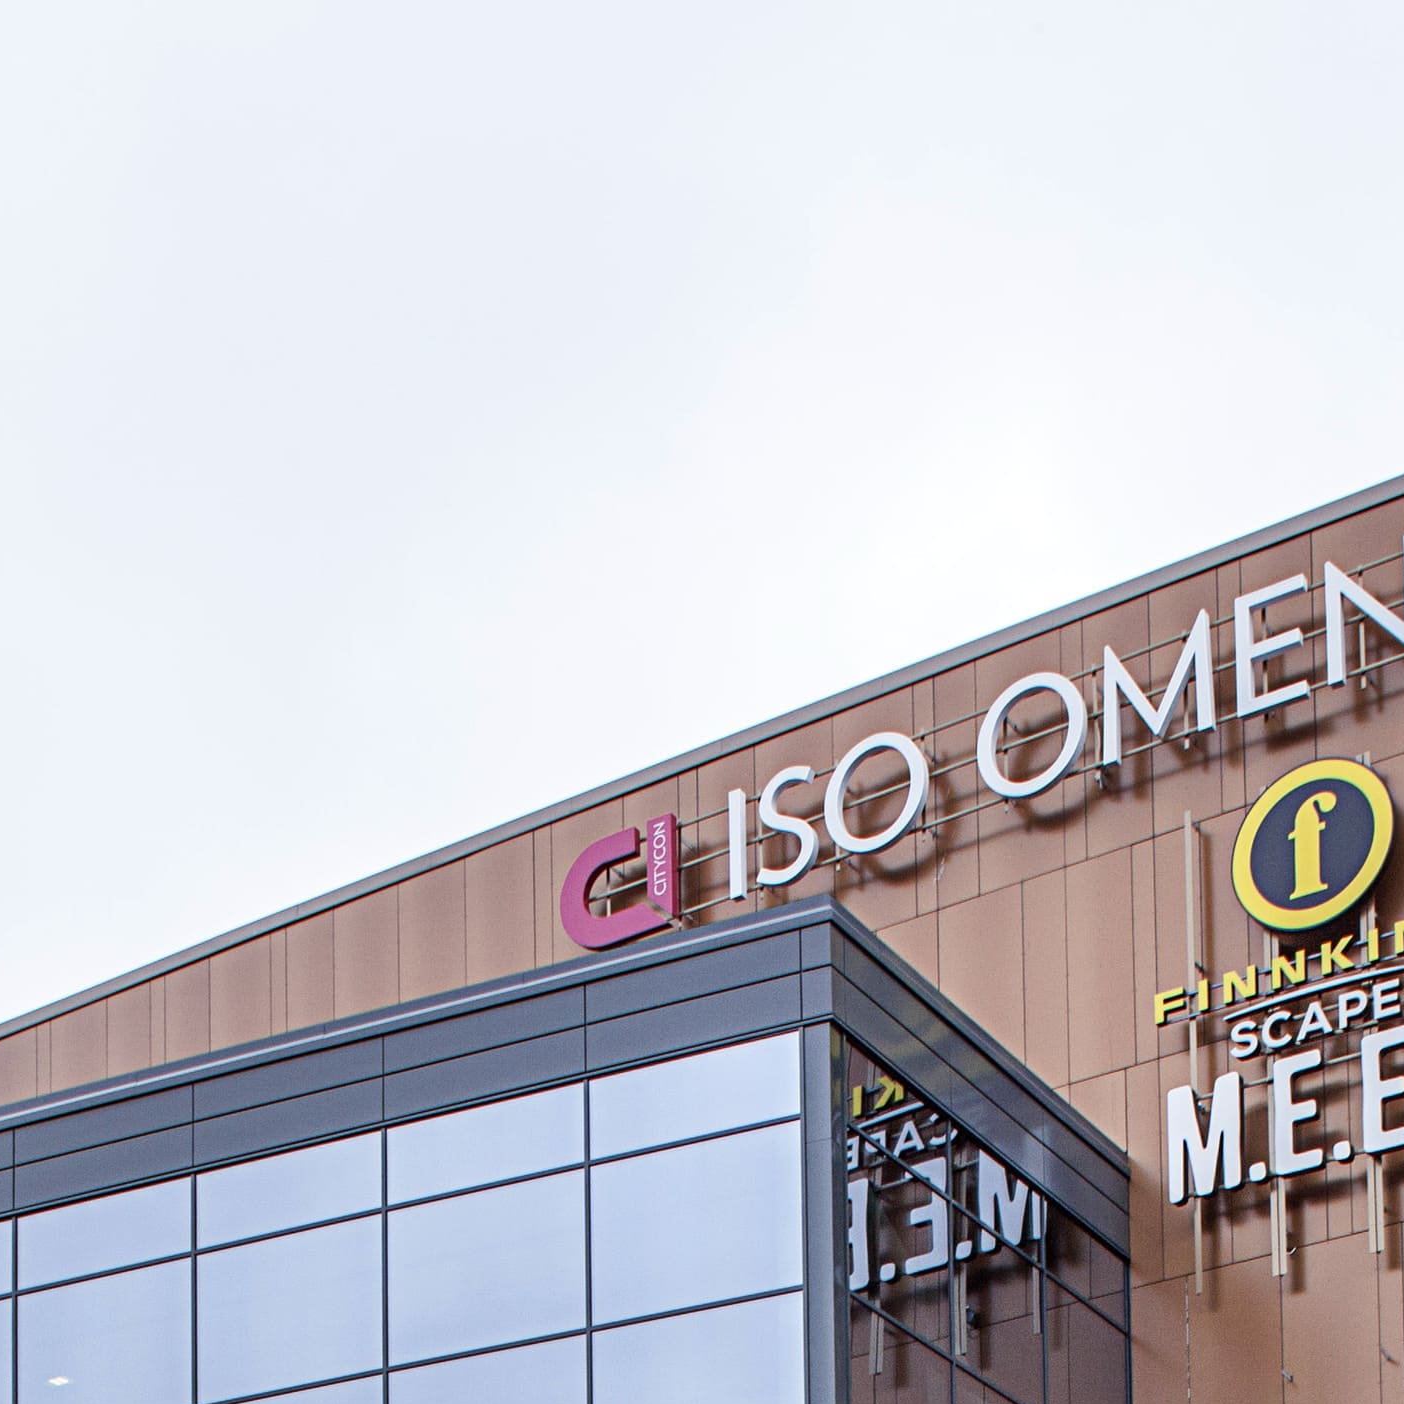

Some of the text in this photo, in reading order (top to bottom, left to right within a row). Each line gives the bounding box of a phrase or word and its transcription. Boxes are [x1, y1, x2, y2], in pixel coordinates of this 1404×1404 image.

[729, 731, 929, 901] ISO
[653, 821, 667, 896] CITYCON
[1230, 978, 1403, 1060] SCAPE
